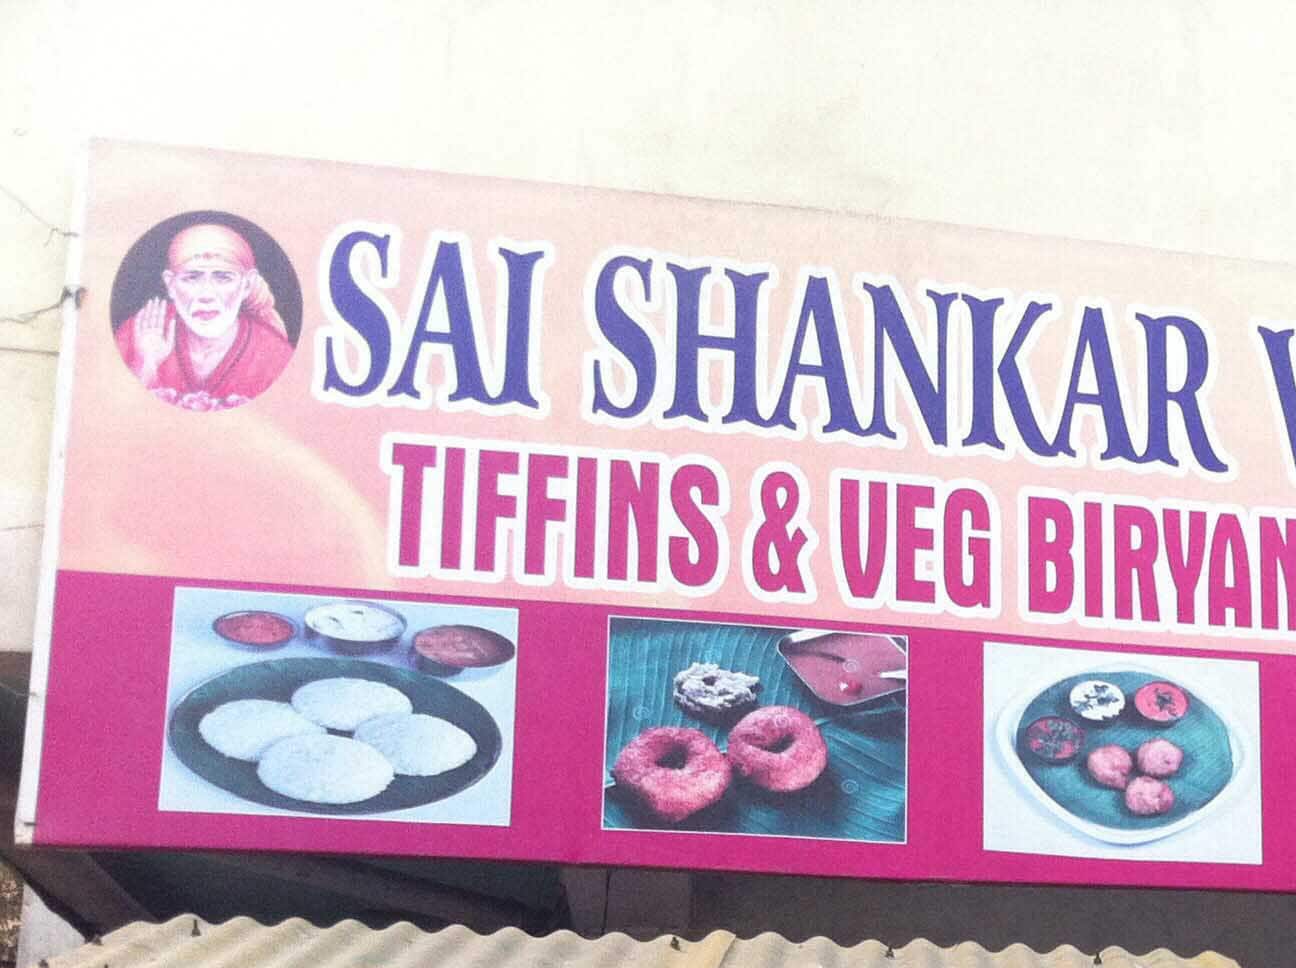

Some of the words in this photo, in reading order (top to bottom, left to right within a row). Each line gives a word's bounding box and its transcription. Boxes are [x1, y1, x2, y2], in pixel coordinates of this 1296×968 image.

[325, 230, 546, 409] SAI
[593, 257, 1229, 474] SHANKAR
[389, 442, 728, 590] TIFFINS
[752, 471, 809, 595] &
[840, 478, 994, 610] VEG
